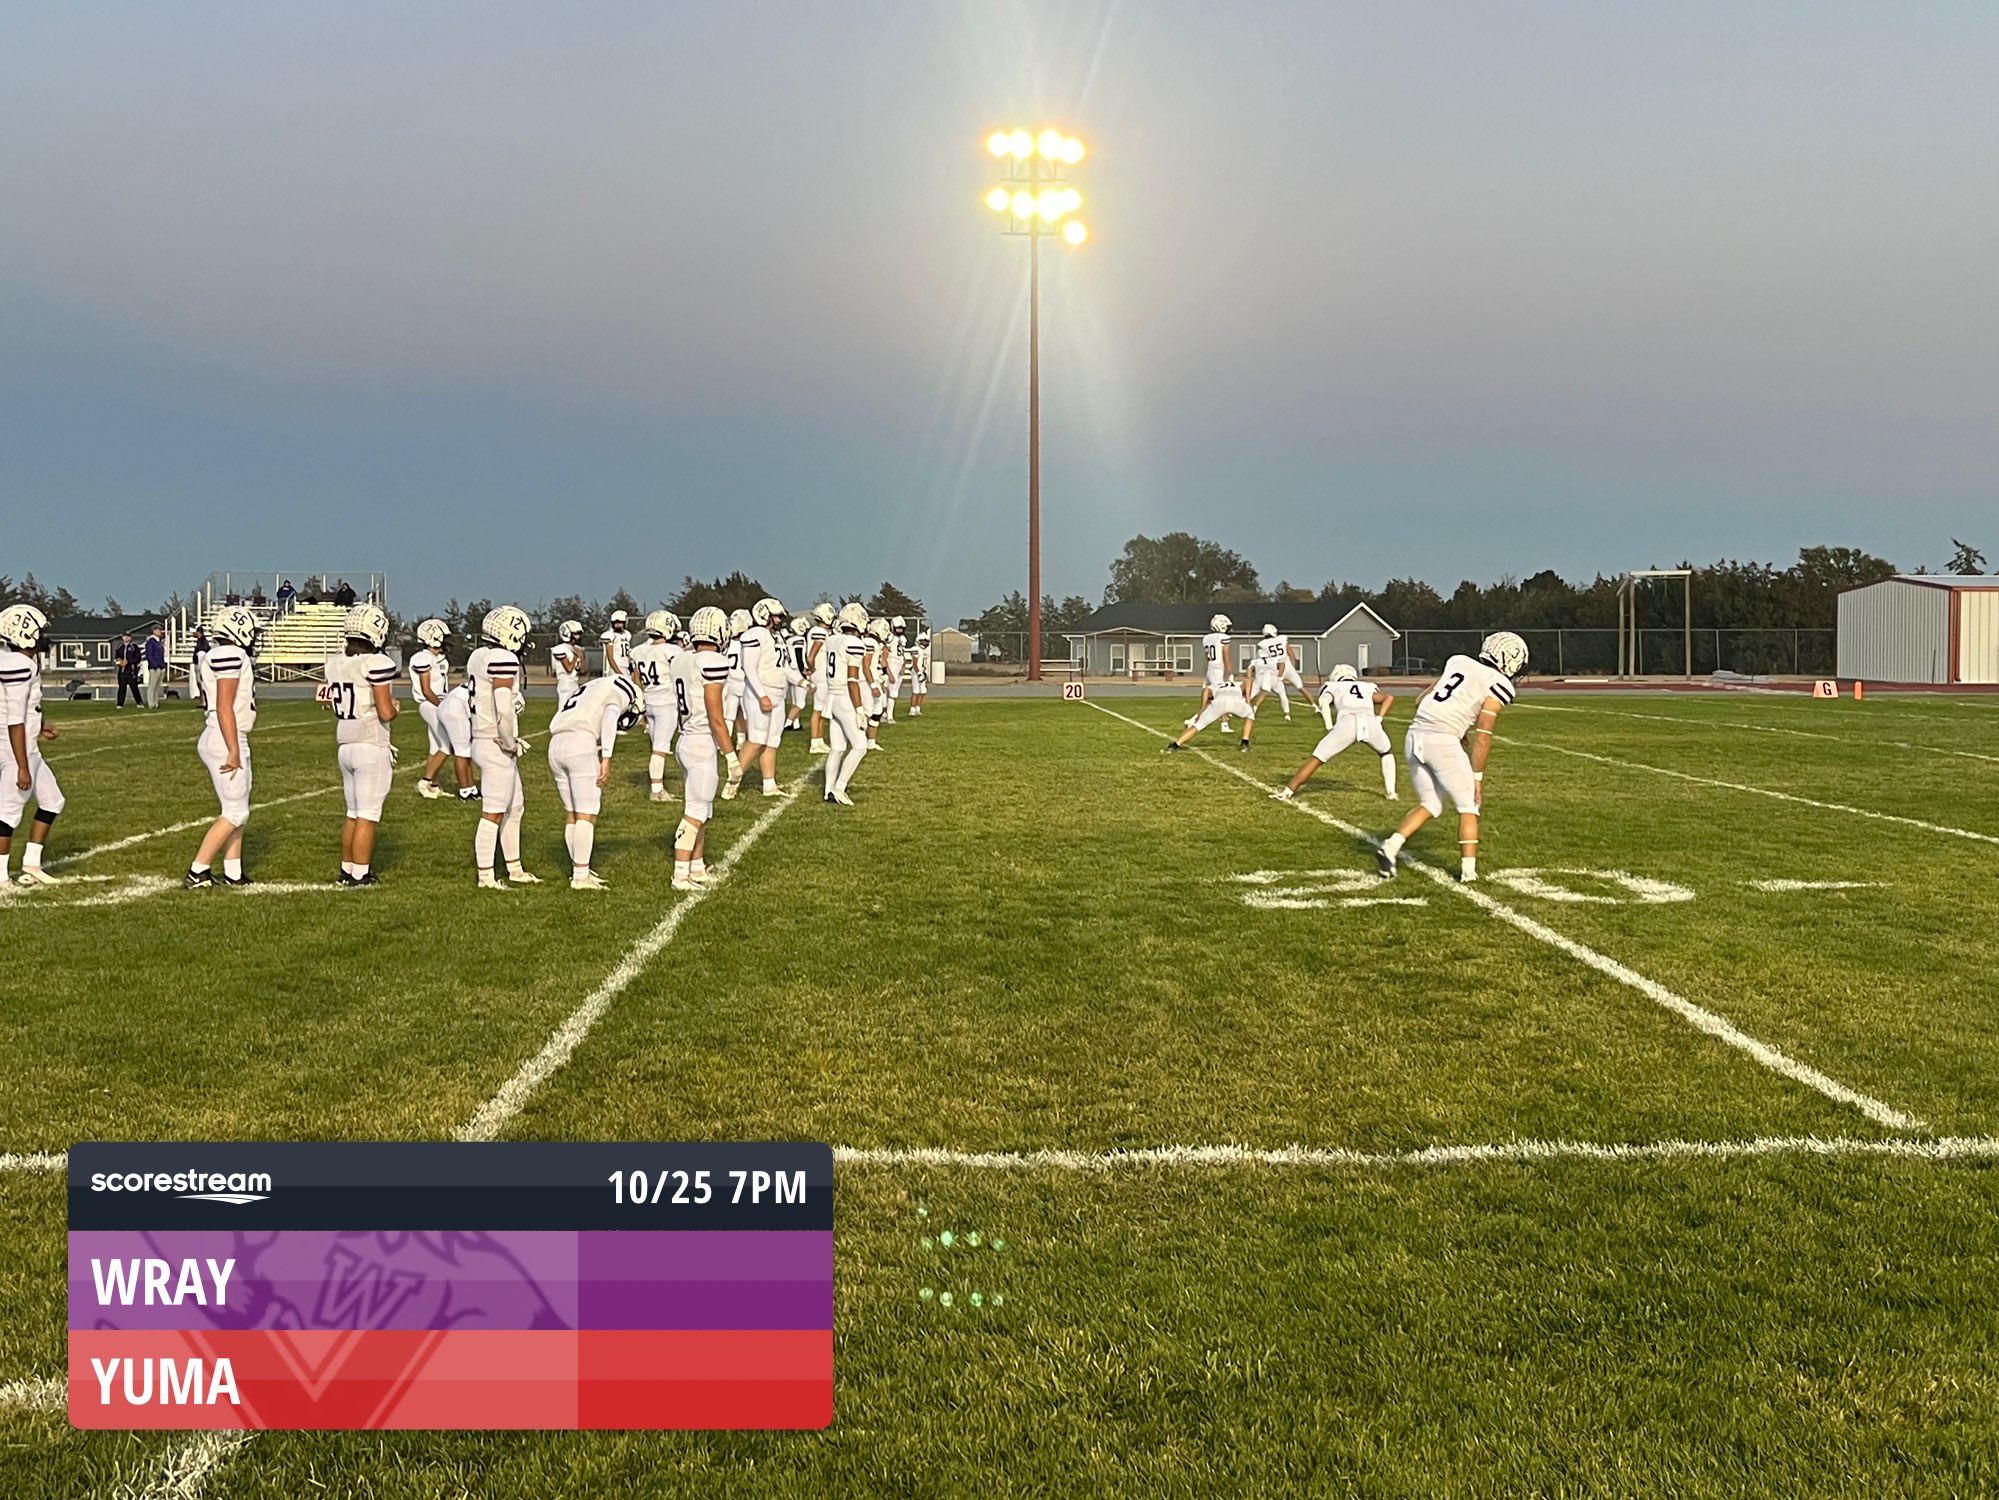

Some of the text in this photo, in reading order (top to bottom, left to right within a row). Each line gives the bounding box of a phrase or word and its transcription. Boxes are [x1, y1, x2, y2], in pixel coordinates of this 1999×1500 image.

[12, 613, 31, 629] 36
[231, 612, 248, 627] 56
[373, 615, 387, 630] 27
[510, 616, 522, 630] 12
[1268, 643, 1285, 658] 55
[637, 661, 661, 686] 64
[1065, 685, 1082, 699] 20
[1349, 684, 1364, 699] 4
[1433, 672, 1465, 703] 3
[1822, 682, 1832, 696] G
[331, 682, 357, 719] 27
[561, 685, 587, 713] 2
